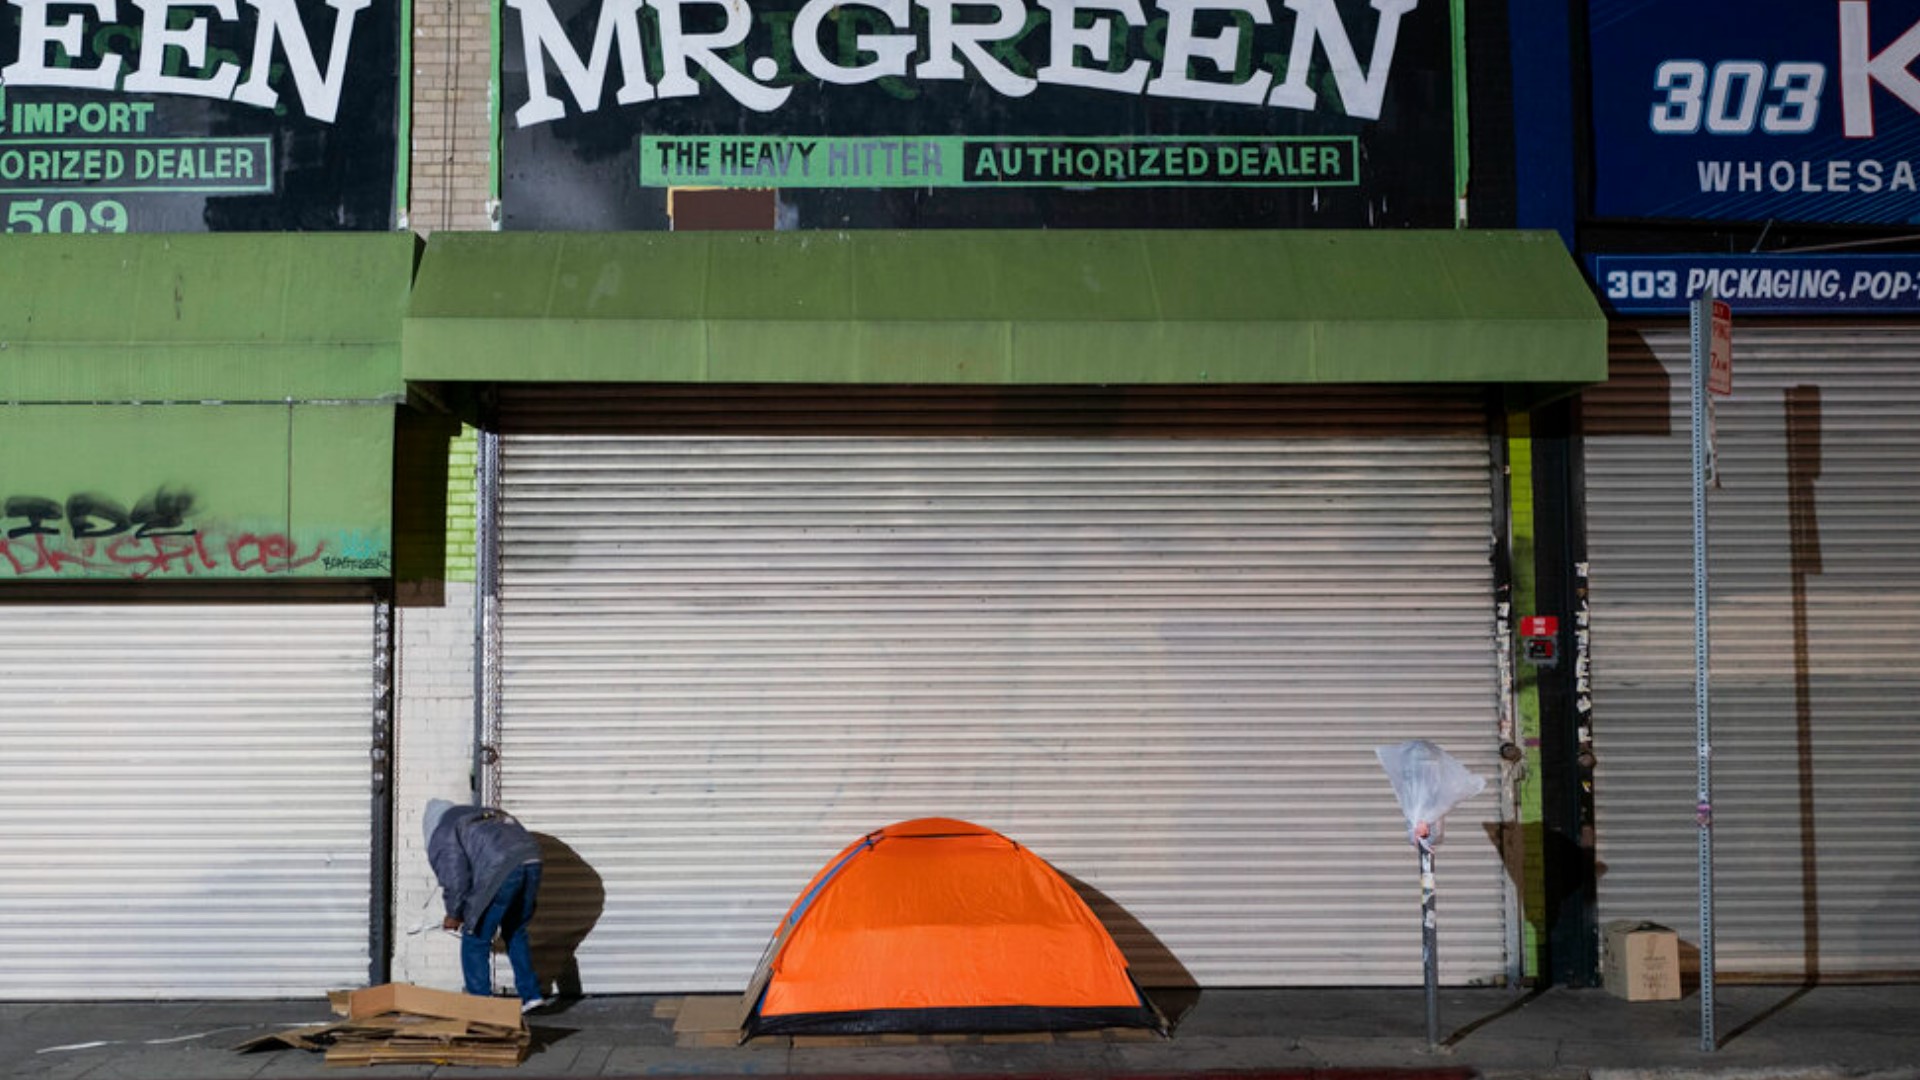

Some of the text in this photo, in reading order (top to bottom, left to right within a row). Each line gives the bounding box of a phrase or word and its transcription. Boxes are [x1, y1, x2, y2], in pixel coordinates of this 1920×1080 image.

[1650, 60, 1827, 135] 303
[12, 101, 155, 134] IMPORT
[0, 147, 254, 180] ORIZED DEALER
[656, 139, 944, 177] THE HEAVY HITTER
[975, 147, 1341, 176] AUTHORIZED DEALER
[1697, 160, 1917, 193] WHOLESA
[1607, 270, 1677, 299] 303
